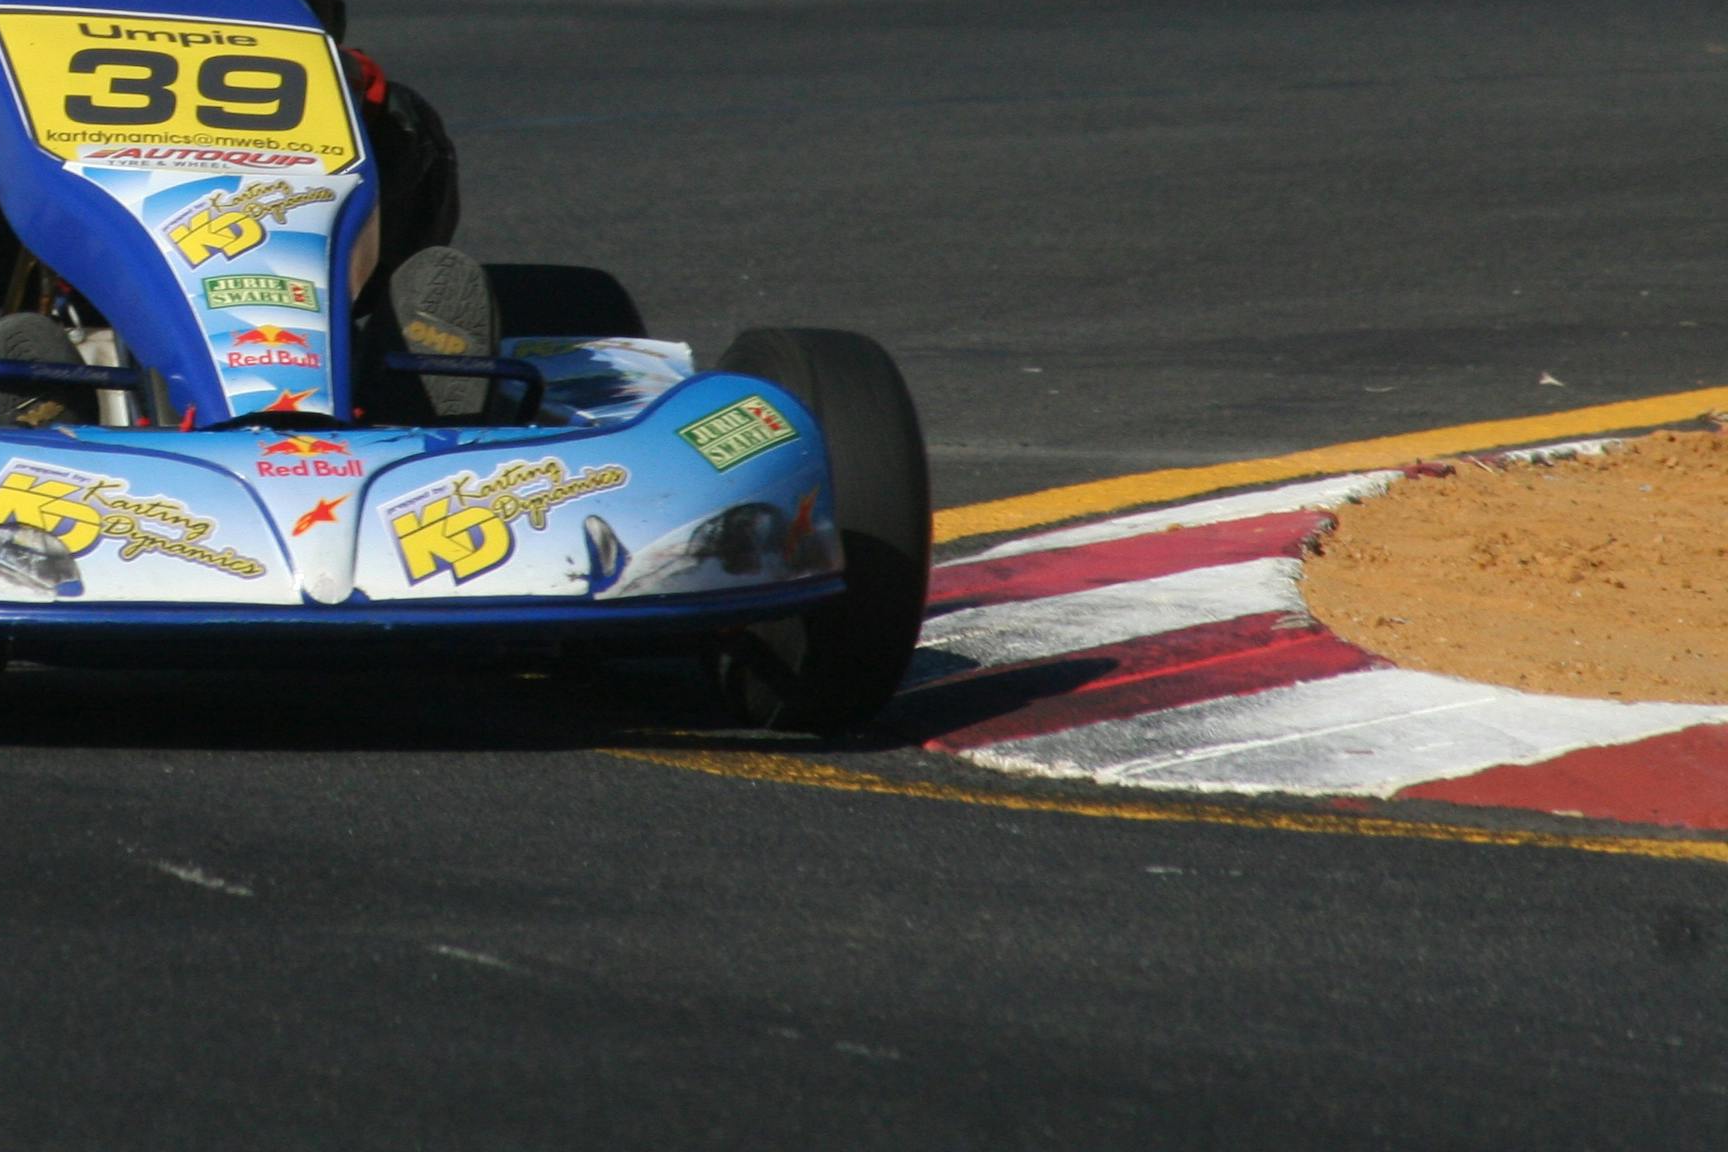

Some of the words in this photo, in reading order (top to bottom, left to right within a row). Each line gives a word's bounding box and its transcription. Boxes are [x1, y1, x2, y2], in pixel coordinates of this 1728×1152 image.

[78, 23, 259, 48] Umpie
[64, 48, 308, 131] 39
[46, 129, 345, 156] kartdynamics@mweb.co.za
[112, 147, 318, 169] AUTOQUIP
[211, 277, 283, 291] JURIE
[211, 290, 290, 305] SWART
[228, 350, 273, 368] Red
[277, 350, 321, 369] Bull
[256, 459, 309, 478] Red
[313, 460, 364, 478] Bull
[453, 462, 561, 506] Karting
[83, 480, 211, 539] Karting
[103, 515, 264, 576] Dynamics
